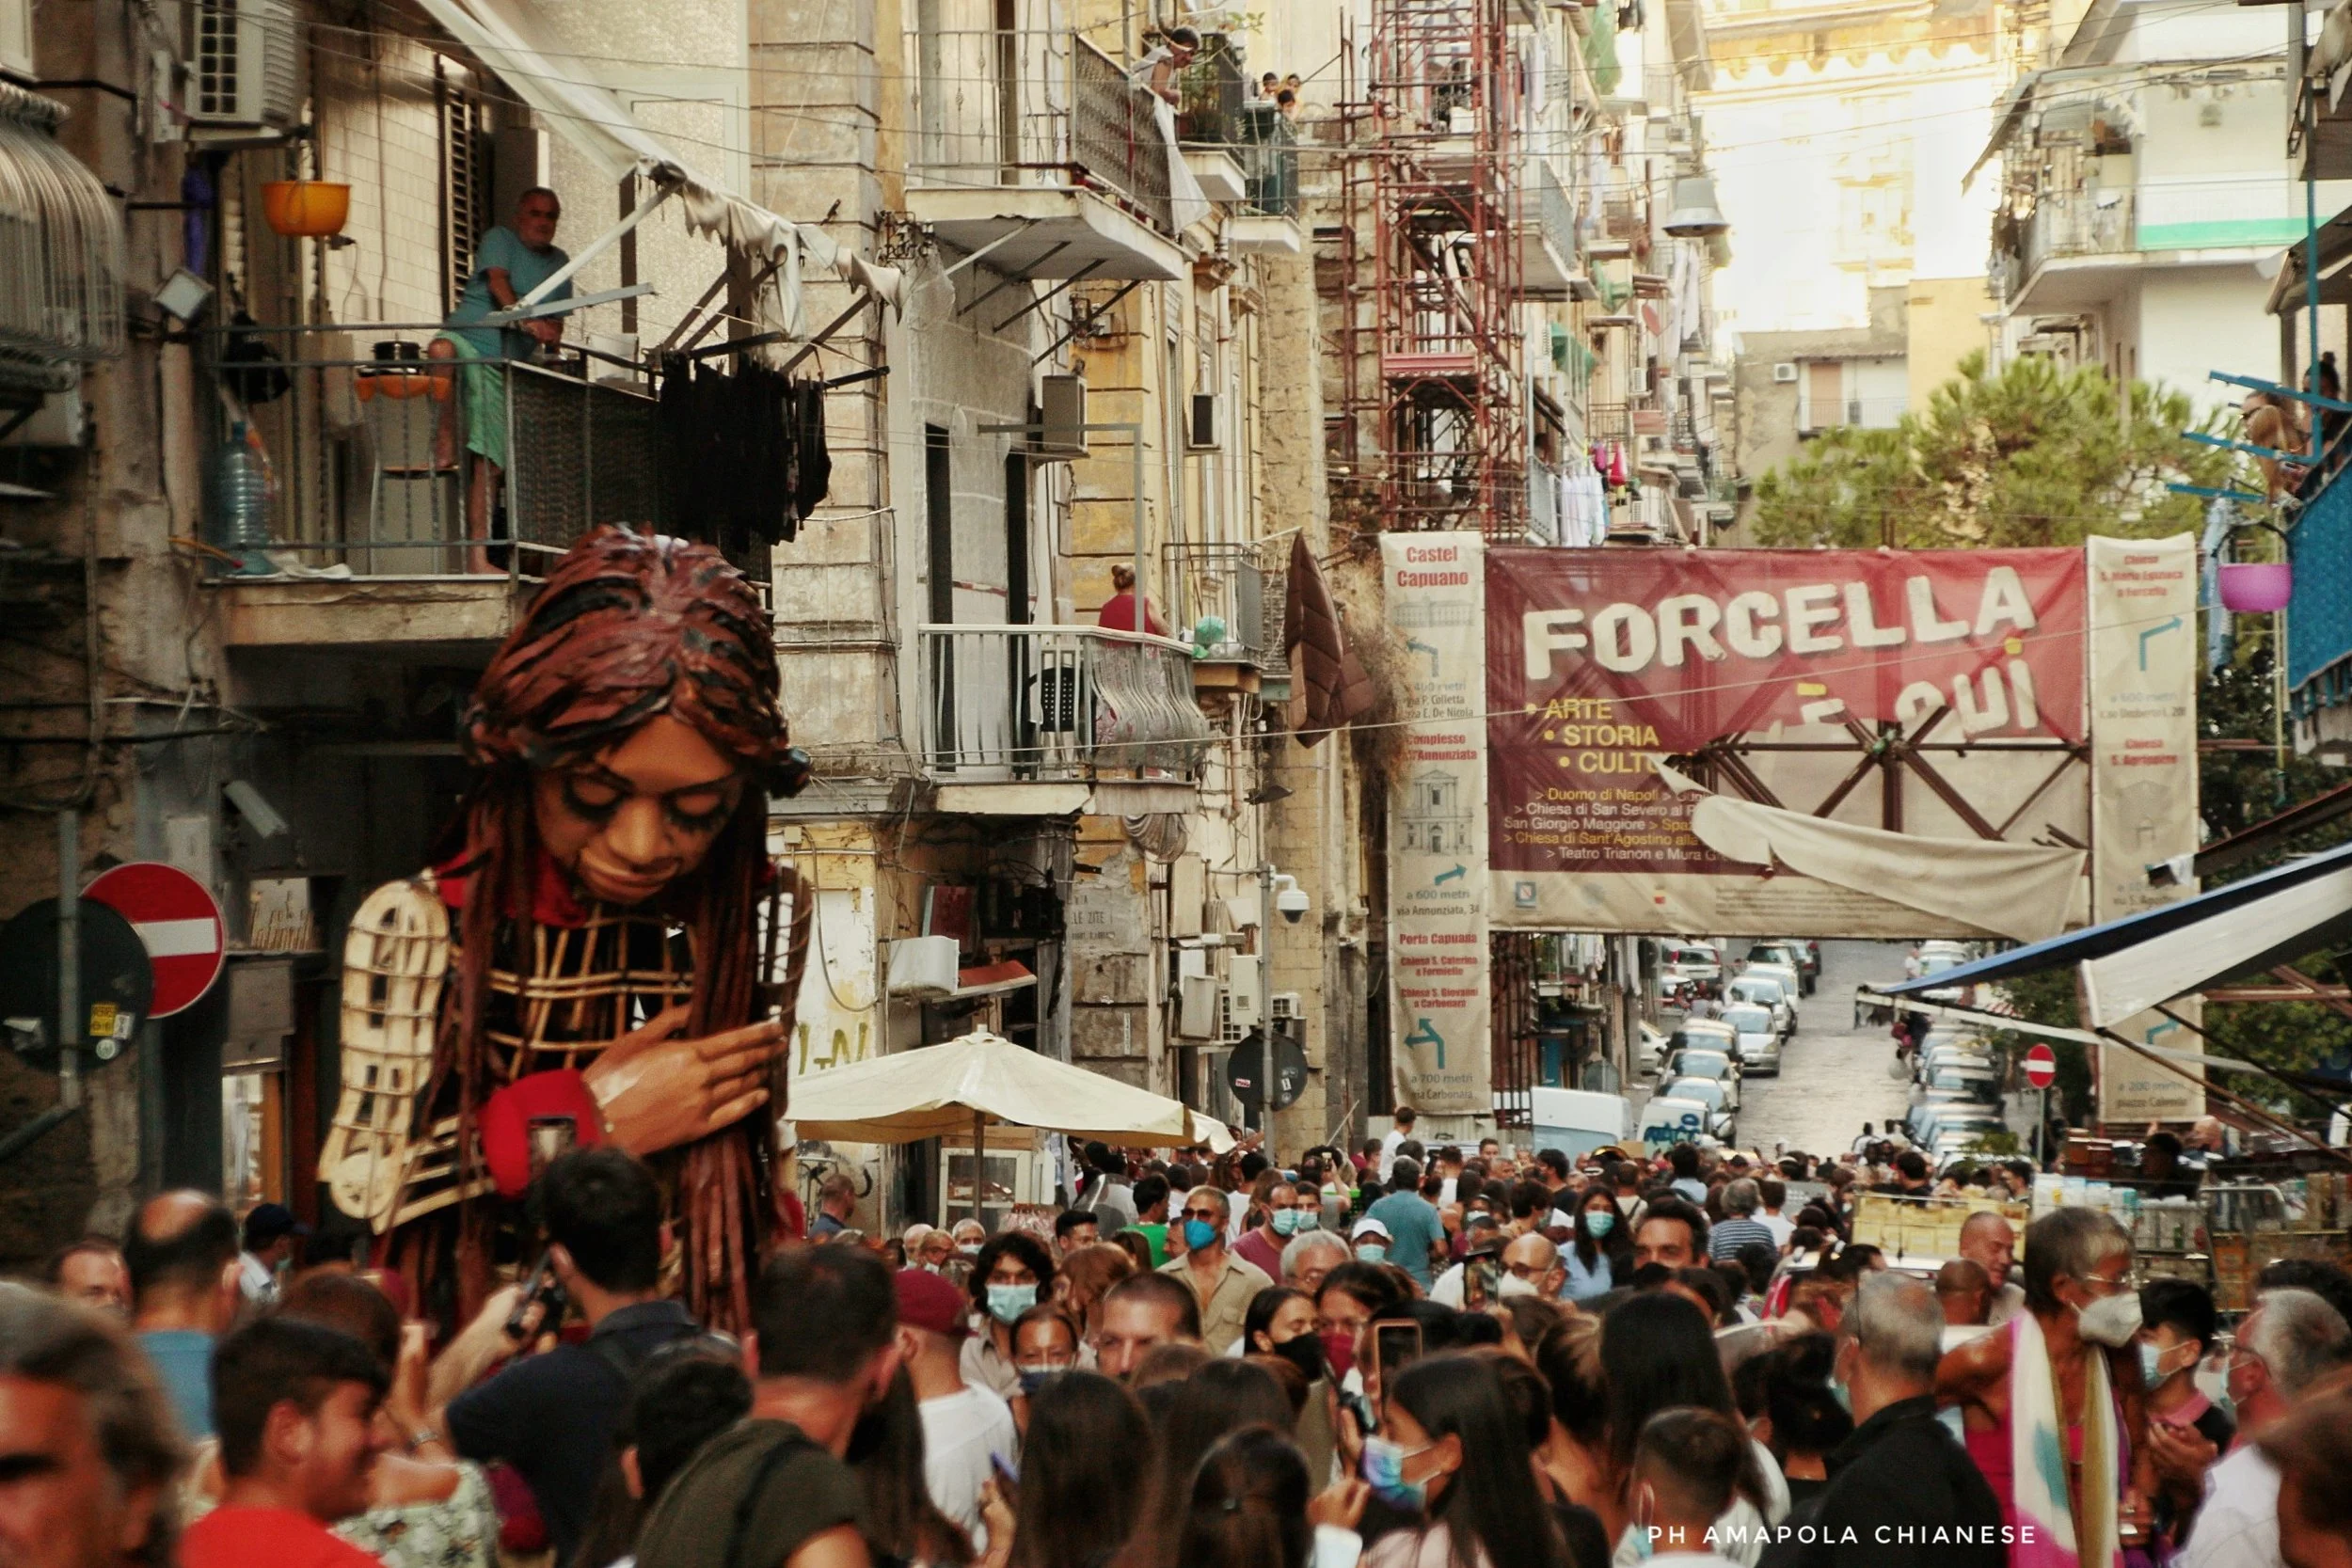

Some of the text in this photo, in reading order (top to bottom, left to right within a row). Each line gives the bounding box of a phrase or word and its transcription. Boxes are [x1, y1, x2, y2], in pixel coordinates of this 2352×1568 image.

[1406, 546, 1459, 563] Castel
[1397, 570, 1470, 588] Capuano
[1523, 566, 2038, 680] FORCELLA
[1431, 693, 1466, 705] Colletta
[1432, 706, 1445, 718] De
[1446, 705, 1474, 718] Nicola
[1545, 698, 1613, 720] ARTE
[1563, 725, 1661, 747] STORIA
[1548, 788, 1597, 800] Duomo
[1599, 787, 1612, 800] di
[1616, 788, 1659, 803] Napoli
[1526, 802, 1572, 816] Chiesa
[1575, 802, 1588, 816] di
[1591, 803, 1618, 816] San
[1621, 804, 1667, 816] Severo
[1670, 804, 1682, 816] al
[1504, 817, 1528, 830] San
[1531, 816, 1580, 832] Giorgio
[1582, 817, 1646, 833] Maggiore
[1515, 832, 1560, 845] Chiesa
[1563, 832, 1576, 845] di
[1579, 833, 1673, 847] Sant'Agostino
[1558, 847, 1600, 860] Teatro
[1602, 847, 1652, 860] Trianon
[1655, 850, 1664, 860] e
[1666, 848, 1702, 861] Mura
[1406, 888, 1470, 900] a 600 metri
[1396, 904, 1480, 917] via Annunziata, 34
[1399, 933, 1478, 945] Porta Capuana
[1400, 956, 1430, 967] Chiesa
[1440, 955, 1478, 966] Caterina
[1400, 988, 1430, 999] Chiesa
[1441, 987, 1479, 998] Giovanni
[1421, 999, 1467, 1009] Carbonara
[1443, 1074, 1473, 1084] metri
